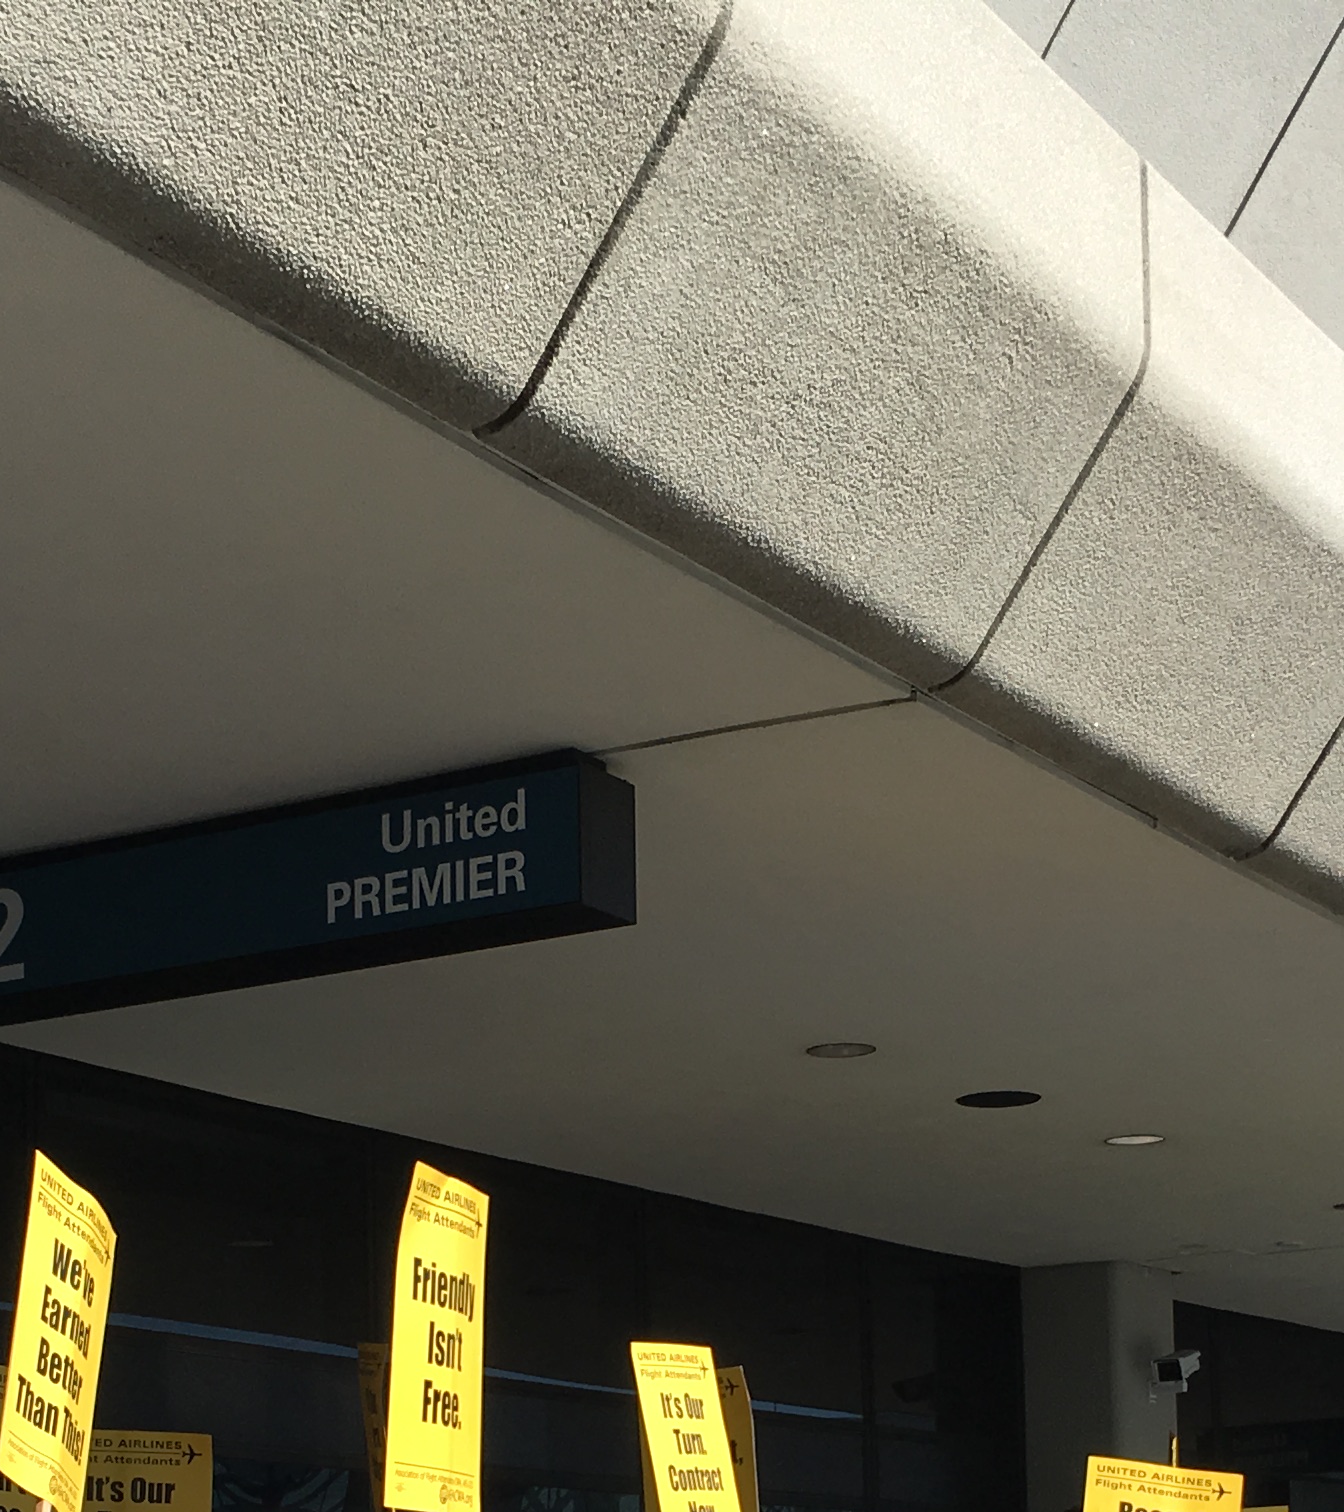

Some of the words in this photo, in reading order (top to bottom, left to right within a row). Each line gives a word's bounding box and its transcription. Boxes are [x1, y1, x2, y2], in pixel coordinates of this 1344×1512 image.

[380, 787, 528, 854] United
[326, 850, 527, 924] PREMIER
[41, 1168, 74, 1206] UNITED
[416, 1177, 441, 1199] UNITED
[444, 1190, 477, 1215] AIRLINES
[37, 1191, 62, 1222] Flight
[409, 1202, 430, 1222] Flight
[433, 1212, 475, 1239] Attendants
[51, 1237, 95, 1308] We've
[412, 1257, 476, 1323] Friendly
[40, 1284, 91, 1360] Earned
[427, 1321, 462, 1372] Isn't
[36, 1336, 83, 1405] Better
[15, 1373, 59, 1437] Than
[61, 1405, 86, 1466] This!
[421, 1379, 462, 1430] Free.
[660, 1392, 684, 1419] It's
[684, 1392, 704, 1419] Our
[104, 1455, 181, 1466] Attendants
[118, 1439, 182, 1450] AIRLINES
[673, 1428, 708, 1455] Turn.
[86, 1475, 124, 1503] It's
[131, 1477, 176, 1504] Our
[668, 1465, 724, 1492] Contract
[1095, 1478, 1133, 1491] Flight
[1137, 1484, 1210, 1501] Attendants
[1096, 1464, 1147, 1479] UNITED
[1151, 1471, 1212, 1487] AIRLINES
